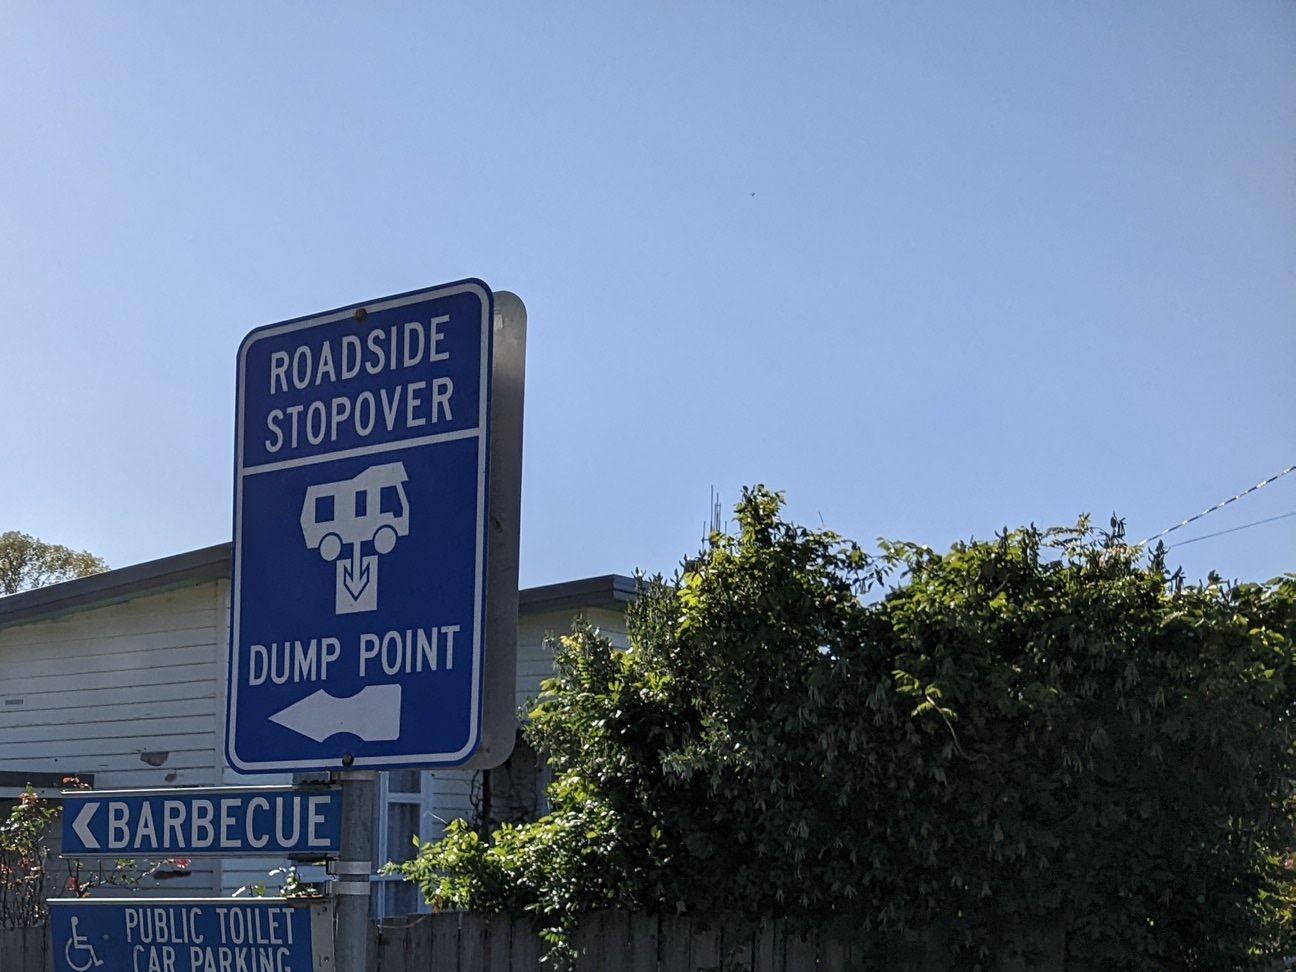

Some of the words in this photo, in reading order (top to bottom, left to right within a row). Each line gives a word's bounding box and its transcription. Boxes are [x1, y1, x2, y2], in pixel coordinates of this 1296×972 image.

[270, 314, 451, 394] ROADSIDE
[264, 376, 454, 454] STOPOVER
[249, 636, 341, 686] DUMP
[359, 625, 461, 678] POINT
[108, 795, 331, 849] BARBECUE
[125, 907, 204, 944] PUBLIC
[216, 906, 295, 945] TOILET
